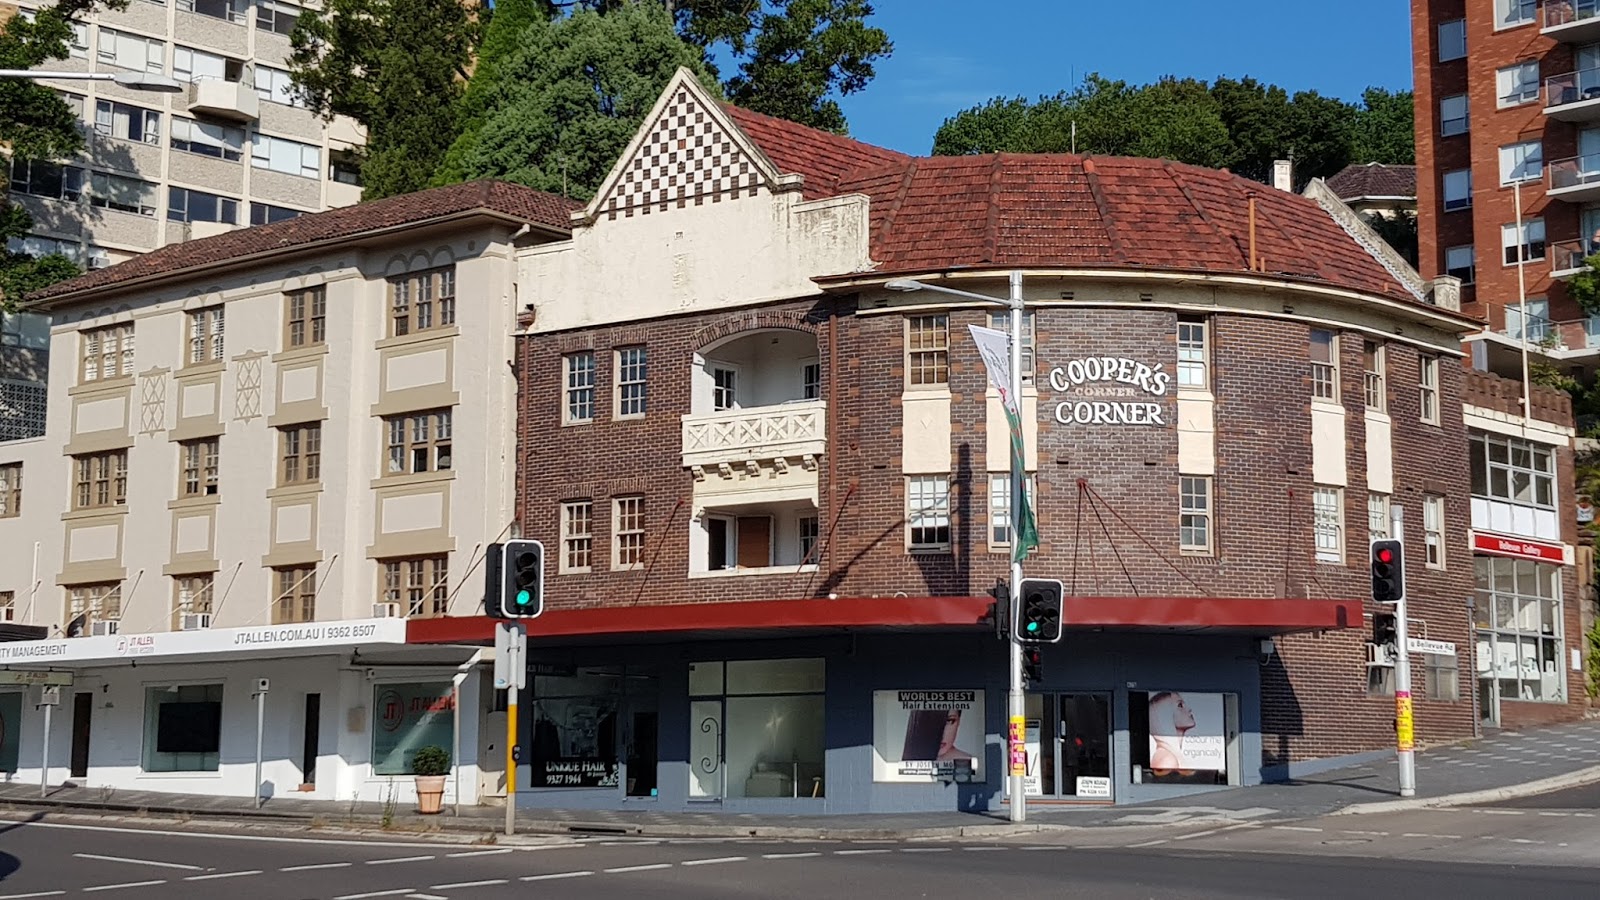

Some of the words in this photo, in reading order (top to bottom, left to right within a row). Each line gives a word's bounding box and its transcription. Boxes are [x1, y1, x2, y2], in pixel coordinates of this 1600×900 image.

[1050, 356, 1171, 396] COOPER'S
[1075, 387, 1136, 396] CORNER
[1055, 401, 1165, 425] CORNER
[234, 629, 319, 645] JTALLEN.COM.AU
[327, 626, 350, 639] 9362
[352, 624, 376, 637] 8507
[0, 647, 11, 658] TY
[12, 644, 67, 657] MANAGEMENT
[900, 692, 945, 701] WORLDS
[947, 692, 972, 701] BEST
[902, 702, 920, 710] Hair
[923, 701, 970, 710] Extensions
[545, 761, 580, 773] UNIQUE
[581, 761, 606, 772] HAIR
